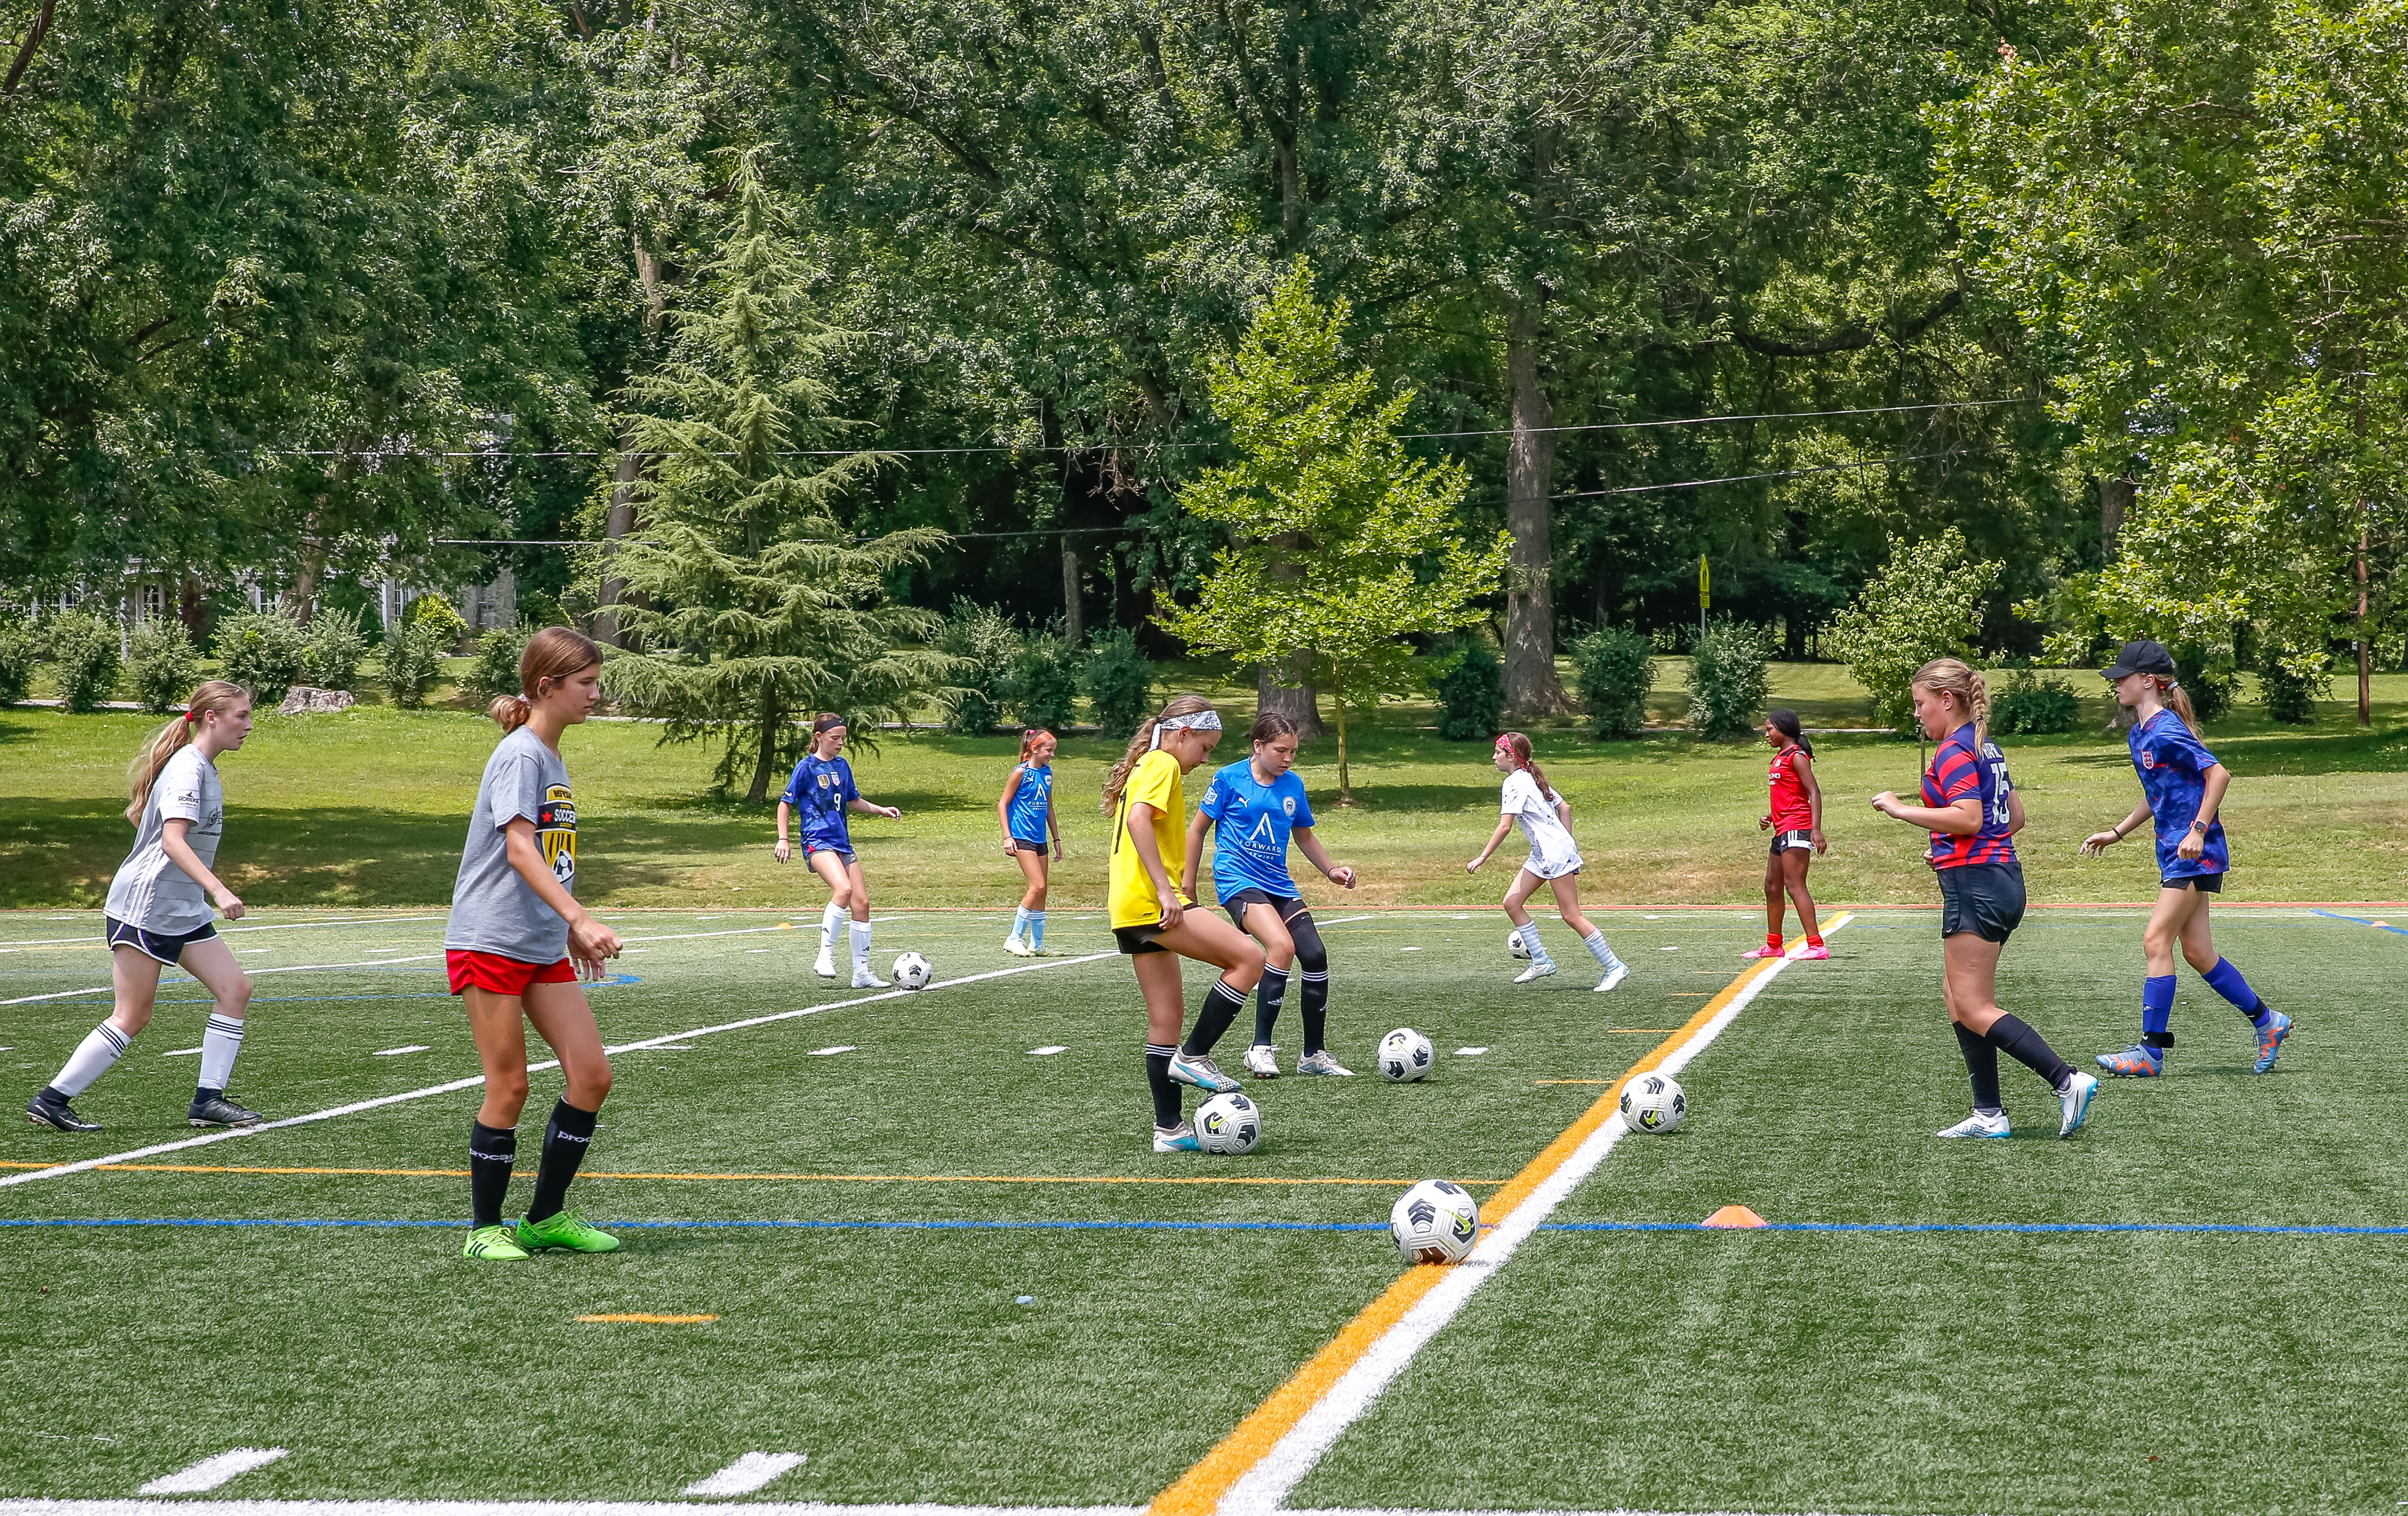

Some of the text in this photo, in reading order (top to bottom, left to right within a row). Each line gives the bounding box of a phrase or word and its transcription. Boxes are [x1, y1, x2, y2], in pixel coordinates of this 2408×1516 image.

[833, 792, 842, 812] 9
[1990, 762, 2011, 824] 15
[1239, 839, 1281, 852] FORWARD
